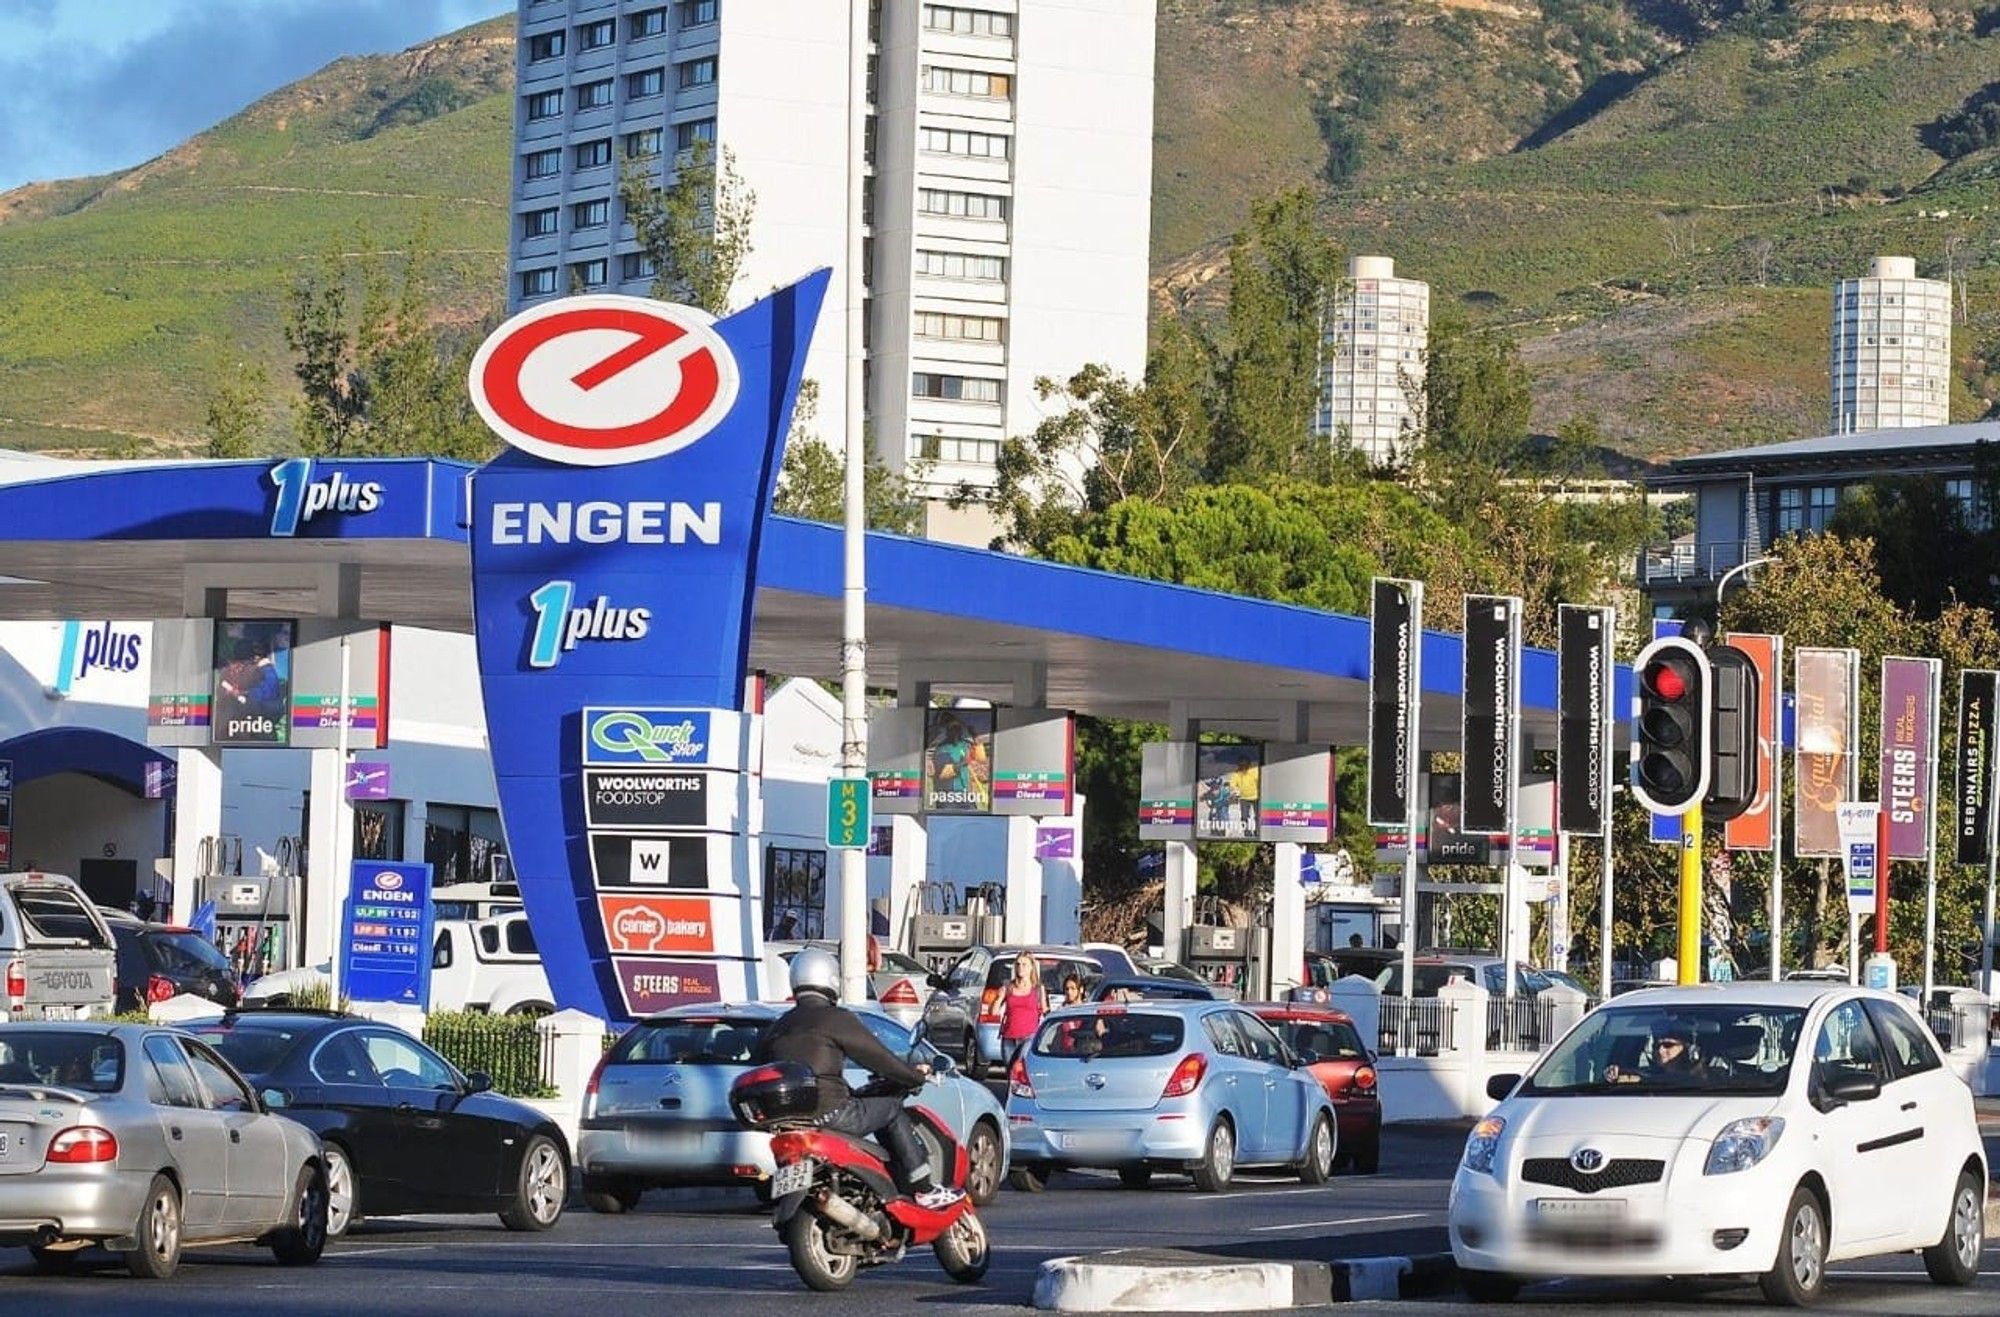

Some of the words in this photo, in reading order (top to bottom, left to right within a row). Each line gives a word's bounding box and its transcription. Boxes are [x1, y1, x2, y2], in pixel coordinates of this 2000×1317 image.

[492, 502, 721, 544] ENGEN
[229, 715, 273, 737] pride
[670, 743, 704, 757] SHOP
[597, 776, 701, 790] WOOLWORTHS
[1892, 750, 1916, 823] STEERS
[1964, 748, 1979, 836] DEBONAIRS
[596, 791, 665, 804] FOODSTOP
[930, 788, 987, 806] passion
[1200, 816, 1256, 834] triumph
[1442, 842, 1476, 856] pride
[639, 853, 660, 870] W
[363, 890, 413, 901] ENGEN
[667, 917, 706, 938] bakery
[44, 971, 93, 989] TOYOTA
[633, 974, 680, 995] STEERS
